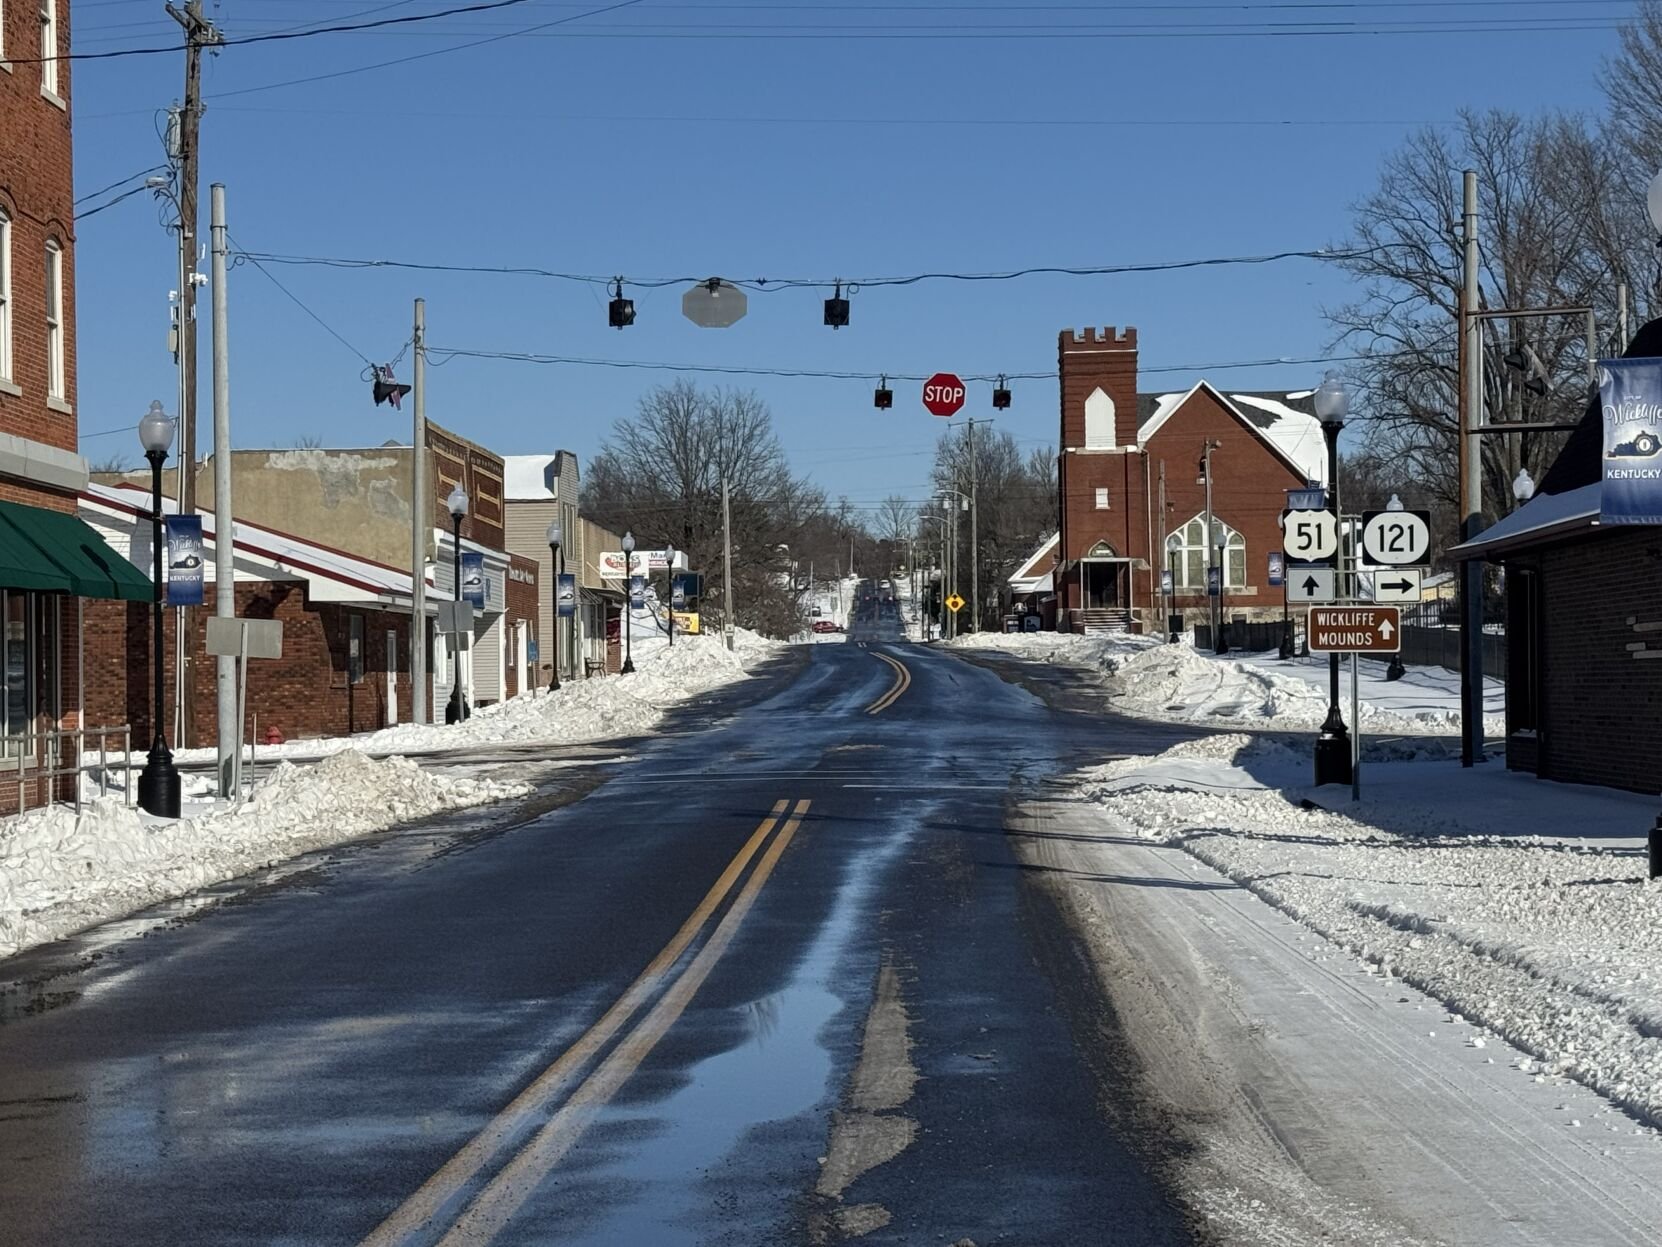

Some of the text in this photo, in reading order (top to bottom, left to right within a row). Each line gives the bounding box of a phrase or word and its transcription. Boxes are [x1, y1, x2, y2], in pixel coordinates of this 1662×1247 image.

[925, 385, 963, 403] STOP
[1607, 469, 1661, 480] KENTUCKY
[1297, 522, 1323, 551] 51
[1377, 523, 1414, 553] 121
[1317, 612, 1375, 626] WICKLIFFE
[1318, 632, 1373, 646] MOUNDS
